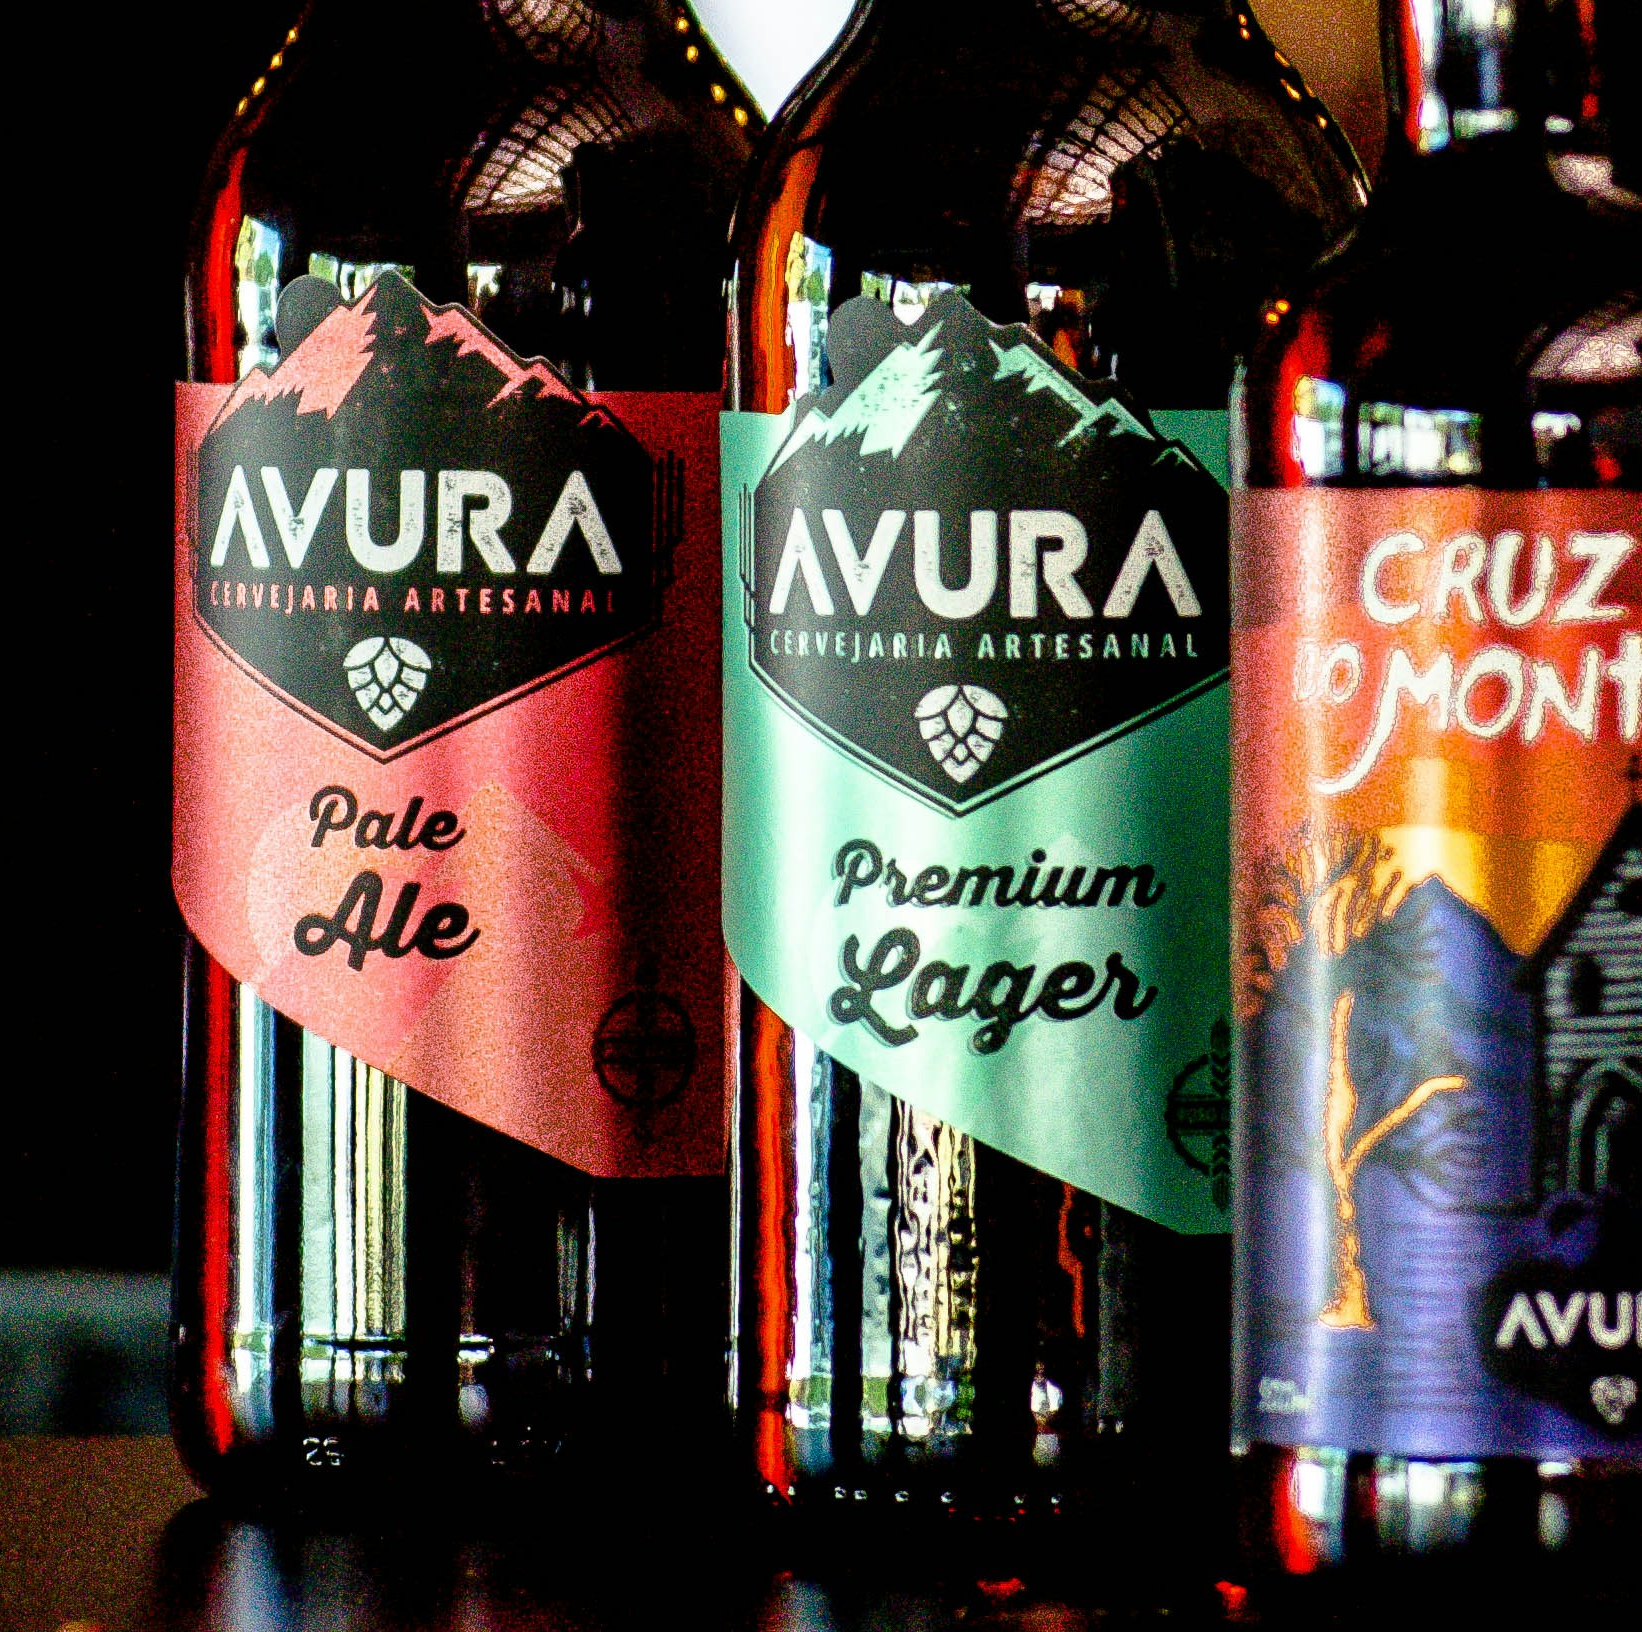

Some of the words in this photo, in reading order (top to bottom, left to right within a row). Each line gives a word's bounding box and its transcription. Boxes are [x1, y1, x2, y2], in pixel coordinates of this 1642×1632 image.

[210, 464, 623, 574] AVURA
[768, 508, 1203, 619] AVURA
[209, 580, 381, 616] CERVEJARIA
[404, 584, 617, 616] ARTESANAL
[1359, 530, 1638, 626] CRUZ
[769, 632, 953, 663] CERVEJARIA
[977, 633, 1199, 659] ARTESANAL
[308, 785, 467, 851] Pale
[293, 871, 481, 972] Ale
[833, 838, 1166, 909] Premium
[827, 927, 1158, 1056] Lager
